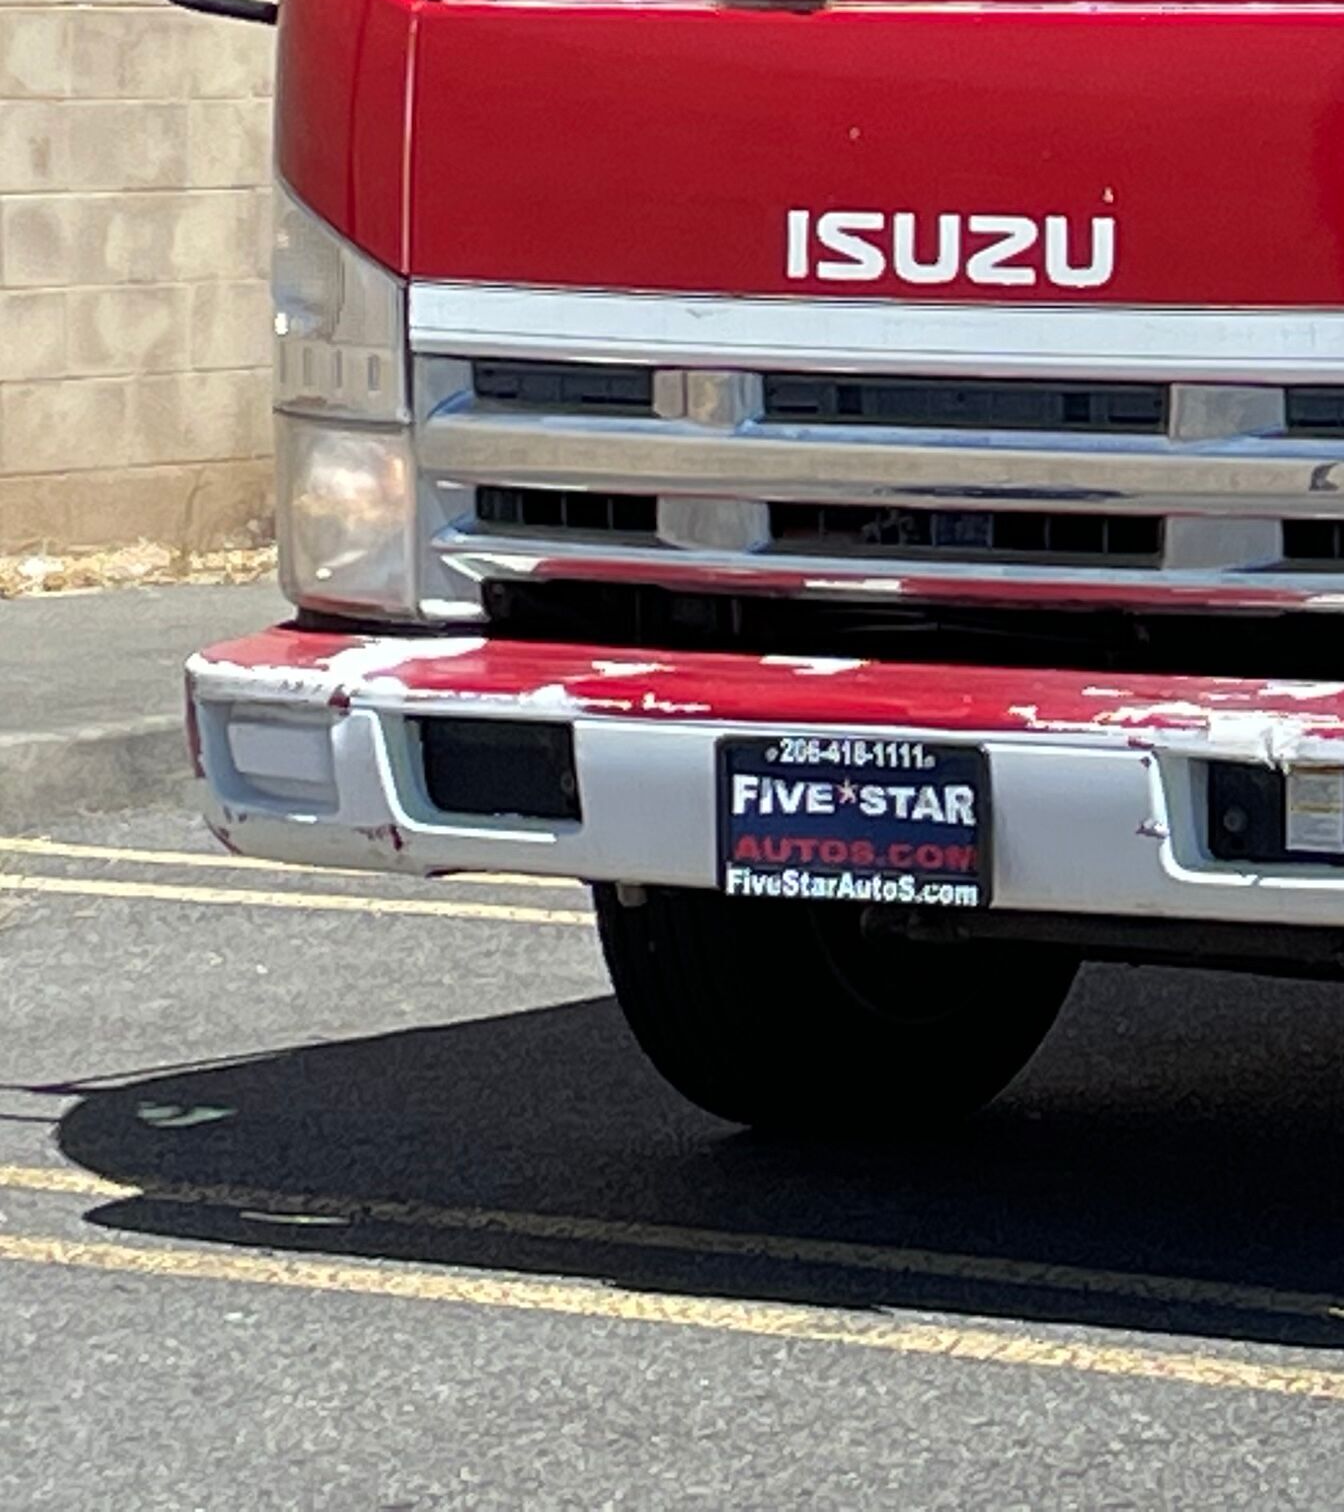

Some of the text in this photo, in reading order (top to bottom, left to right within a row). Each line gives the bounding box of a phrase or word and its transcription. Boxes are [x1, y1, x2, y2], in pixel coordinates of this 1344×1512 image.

[787, 210, 1114, 287] ISUZU
[732, 773, 977, 826] FIVE STAR
[735, 835, 978, 870] AUTOS.COM
